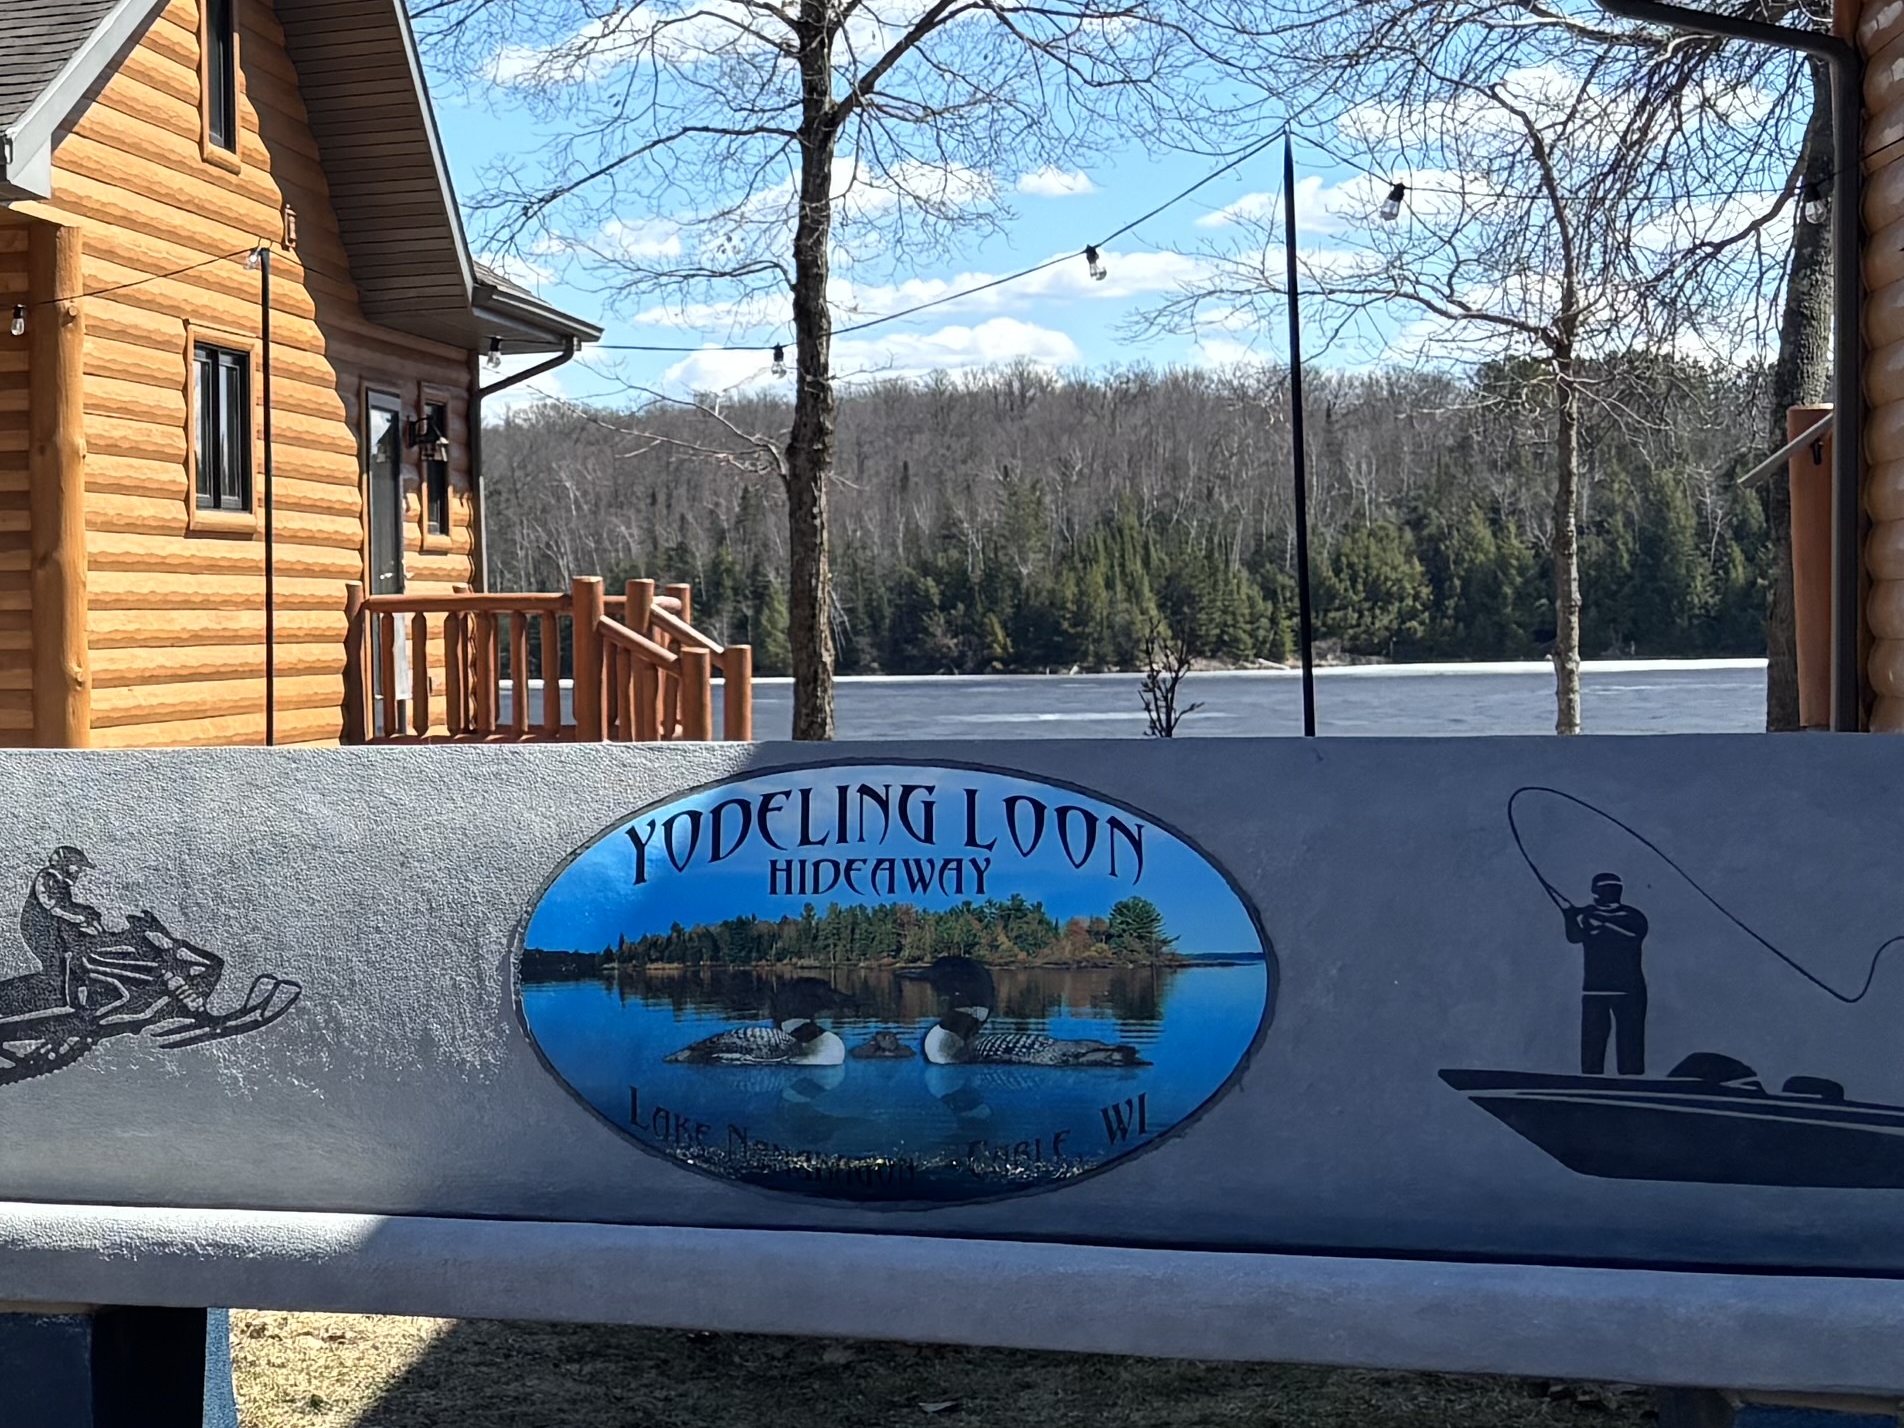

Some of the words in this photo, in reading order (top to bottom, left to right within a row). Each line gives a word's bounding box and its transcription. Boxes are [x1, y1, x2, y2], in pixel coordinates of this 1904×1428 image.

[625, 783, 934, 885] YODELING
[963, 788, 1146, 885] LOON
[767, 857, 991, 895] HIDEAWAY
[1100, 1092, 1147, 1145] WI
